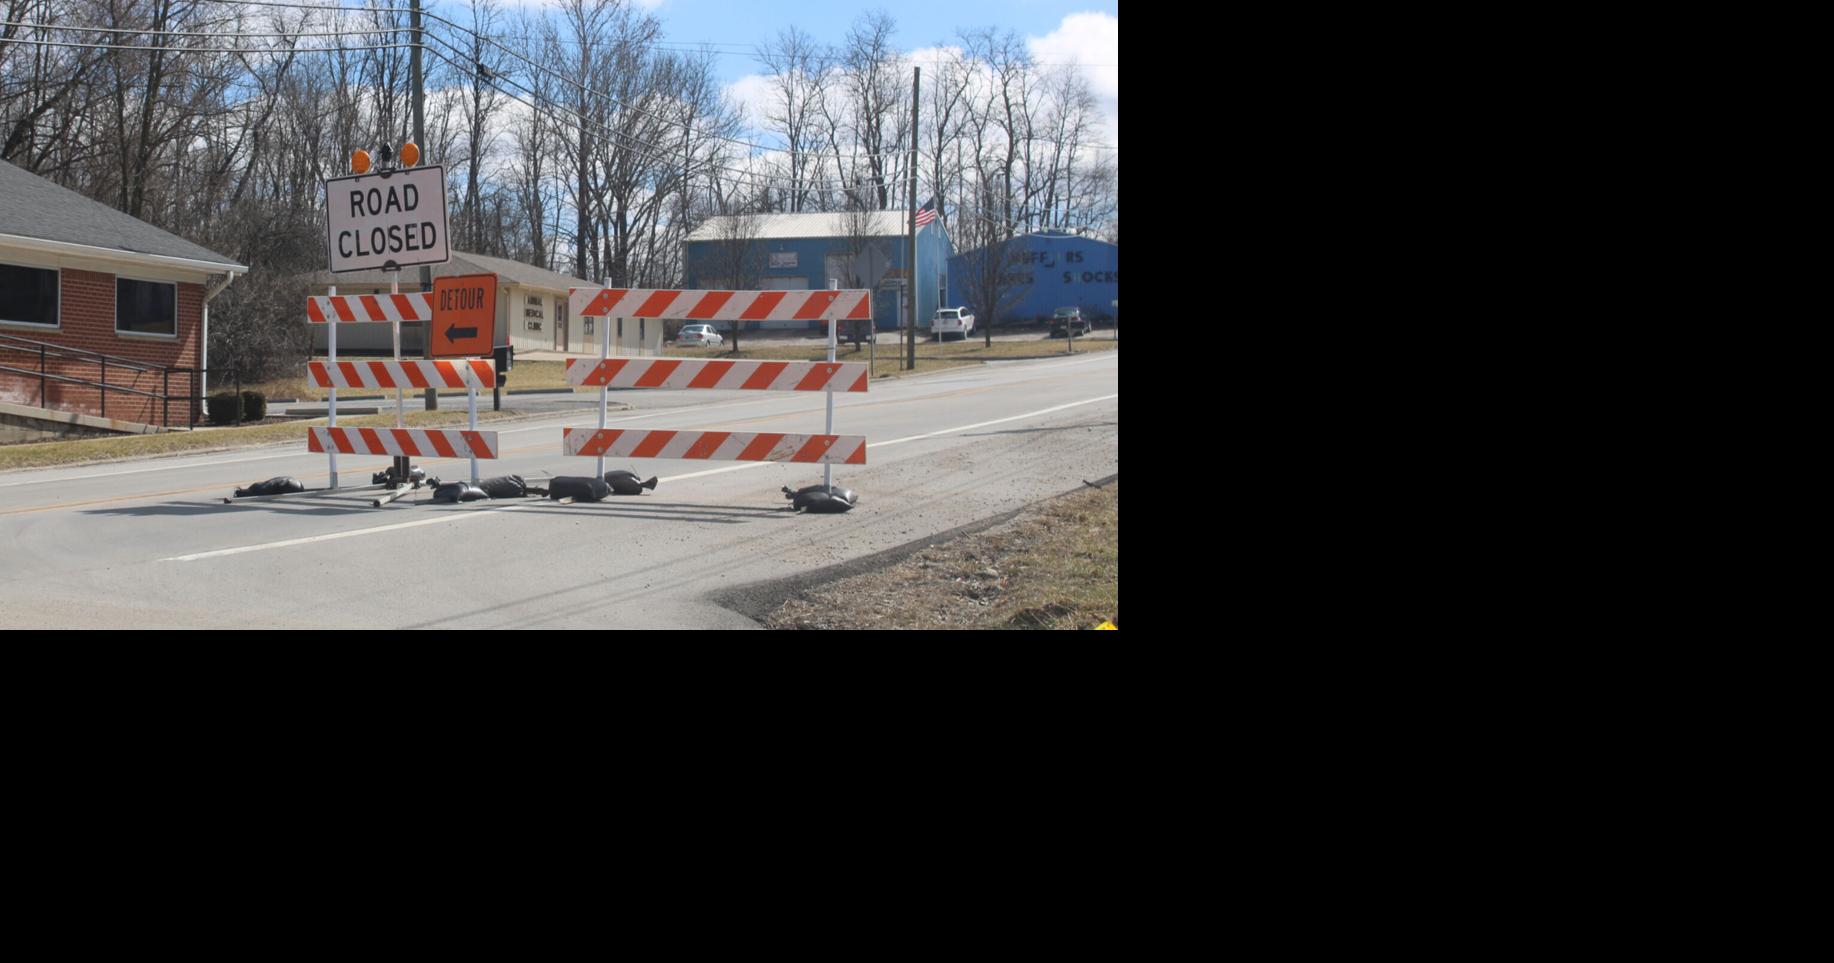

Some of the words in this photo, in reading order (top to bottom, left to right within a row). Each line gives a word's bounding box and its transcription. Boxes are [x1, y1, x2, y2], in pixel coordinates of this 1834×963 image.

[350, 183, 419, 218] ROAD
[338, 221, 437, 259] CLOSED
[439, 287, 484, 311] DETOUR
